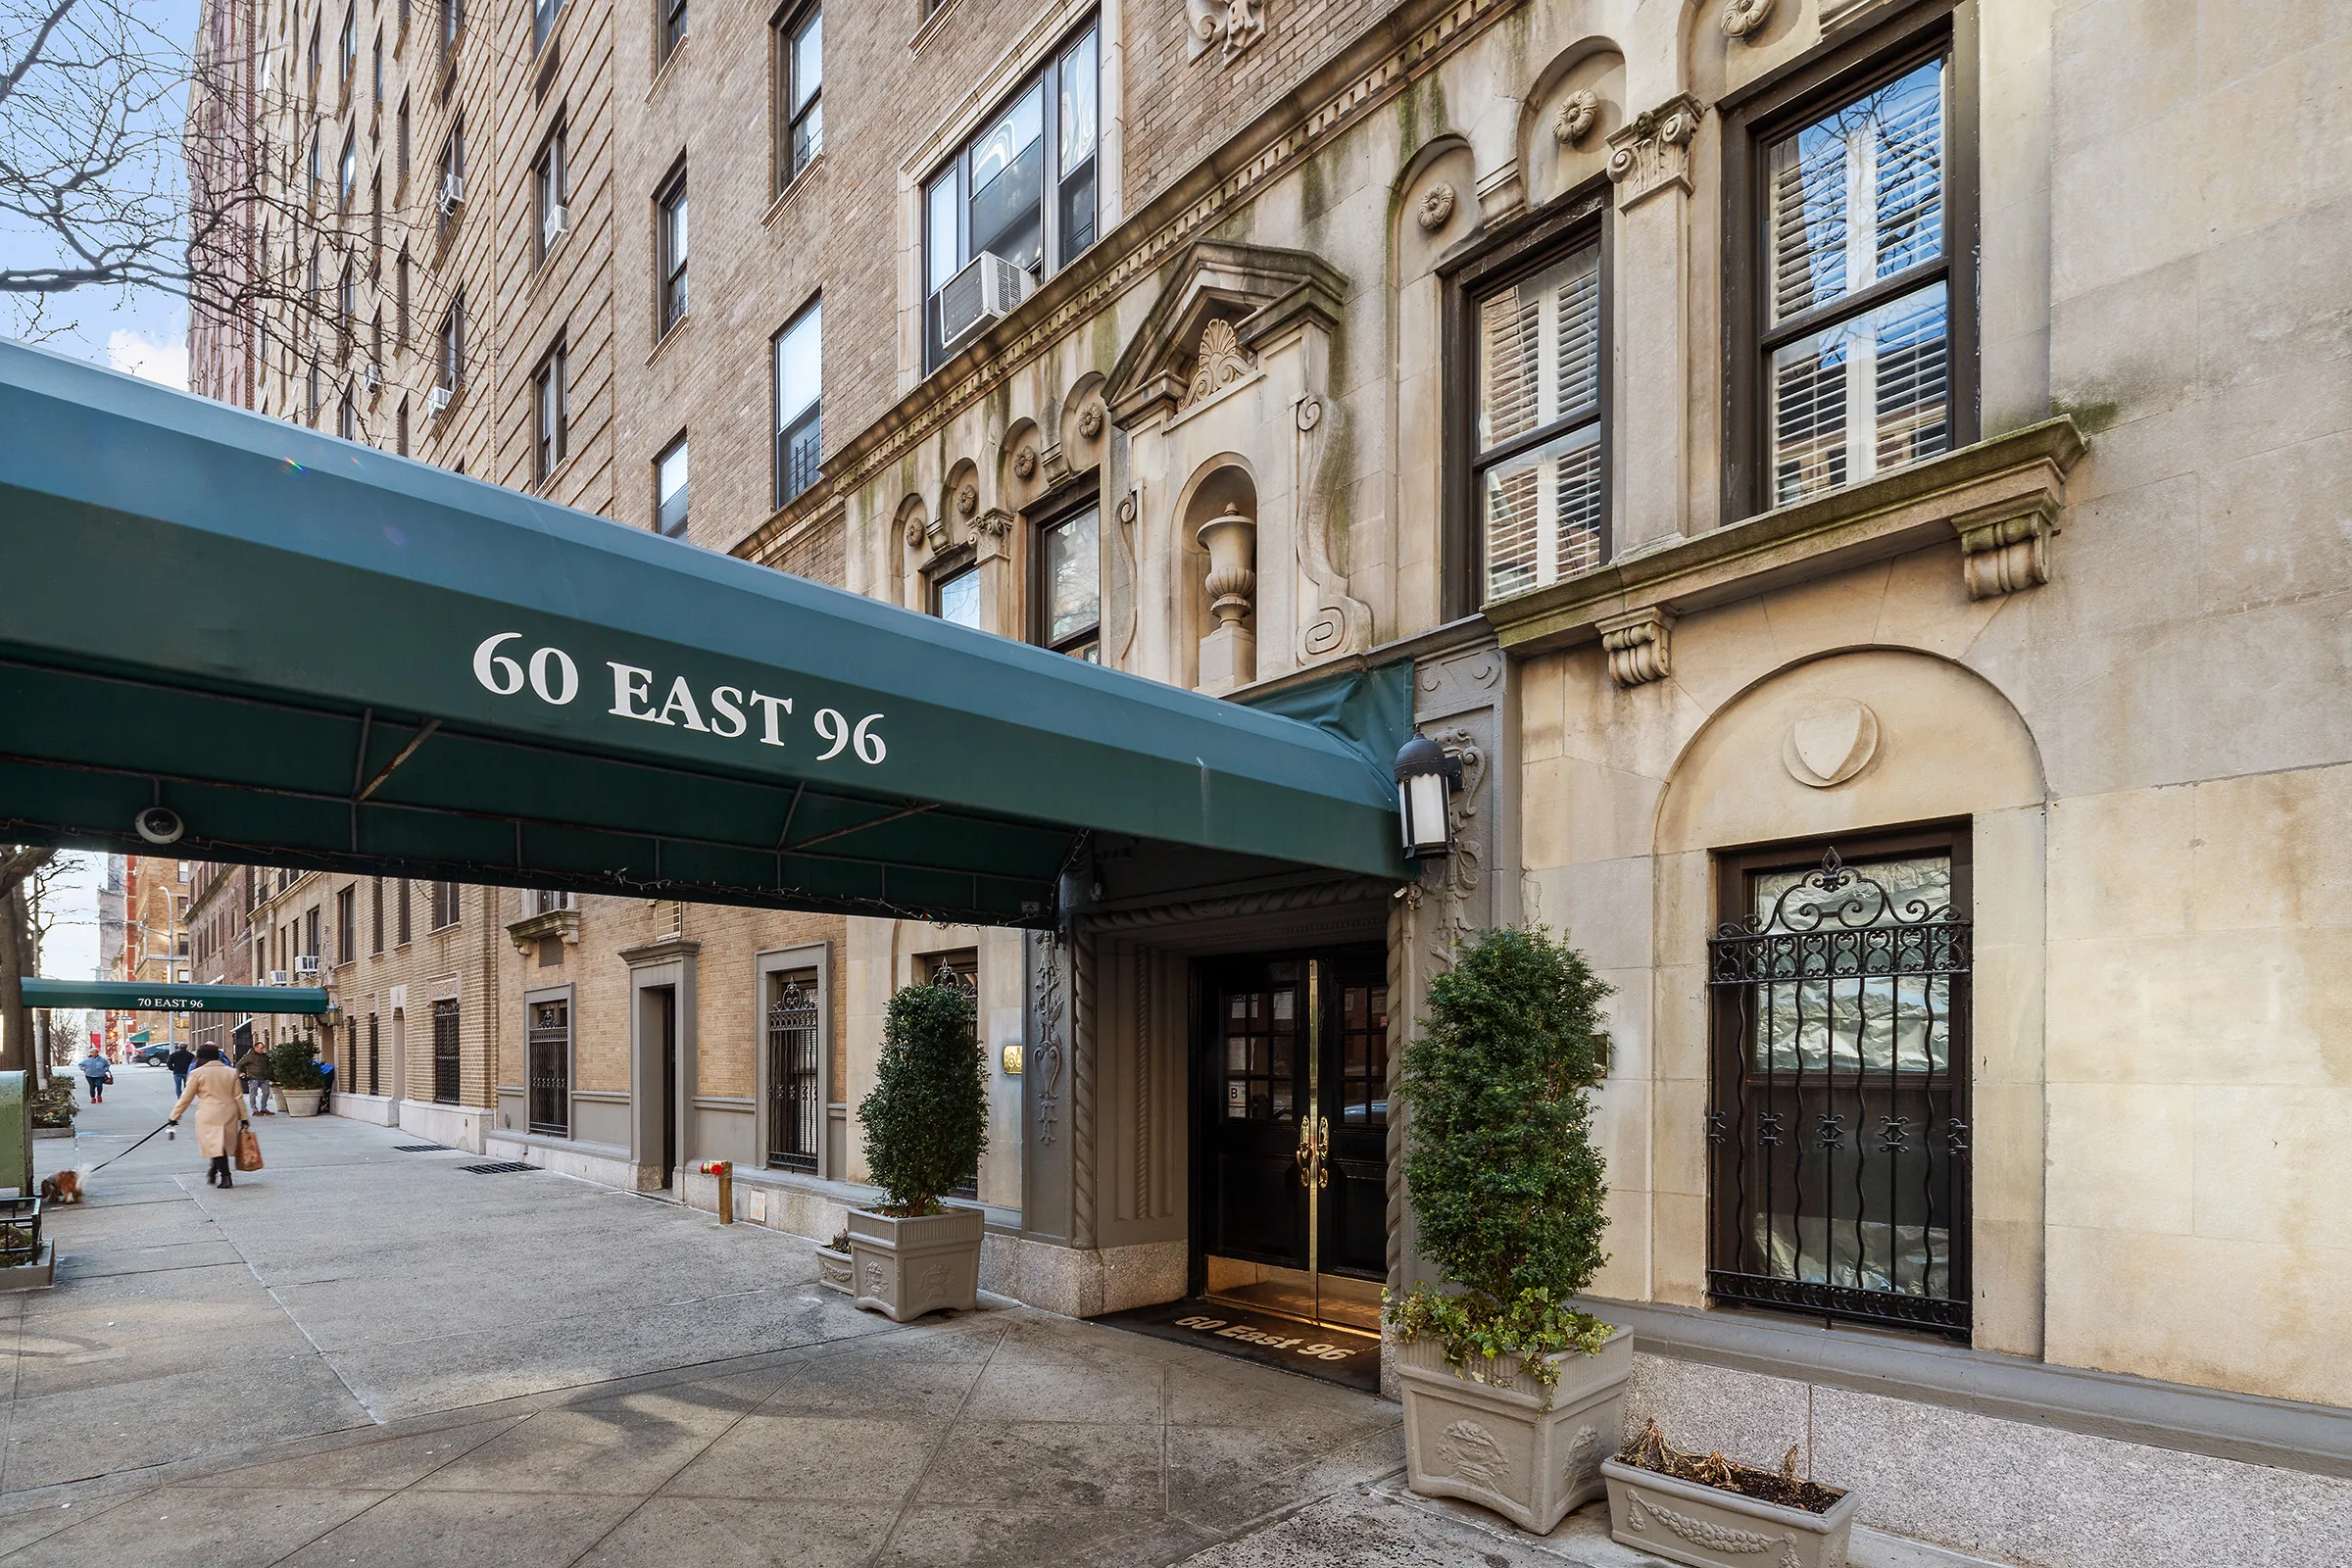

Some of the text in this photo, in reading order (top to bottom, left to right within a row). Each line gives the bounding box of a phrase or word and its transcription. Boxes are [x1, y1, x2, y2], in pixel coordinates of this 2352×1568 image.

[472, 631, 887, 764] 60 EAST 96
[137, 998, 204, 1008] 70 EAST 96
[1231, 1088, 1238, 1099] B
[1175, 1315, 1356, 1360] 60 East 96
